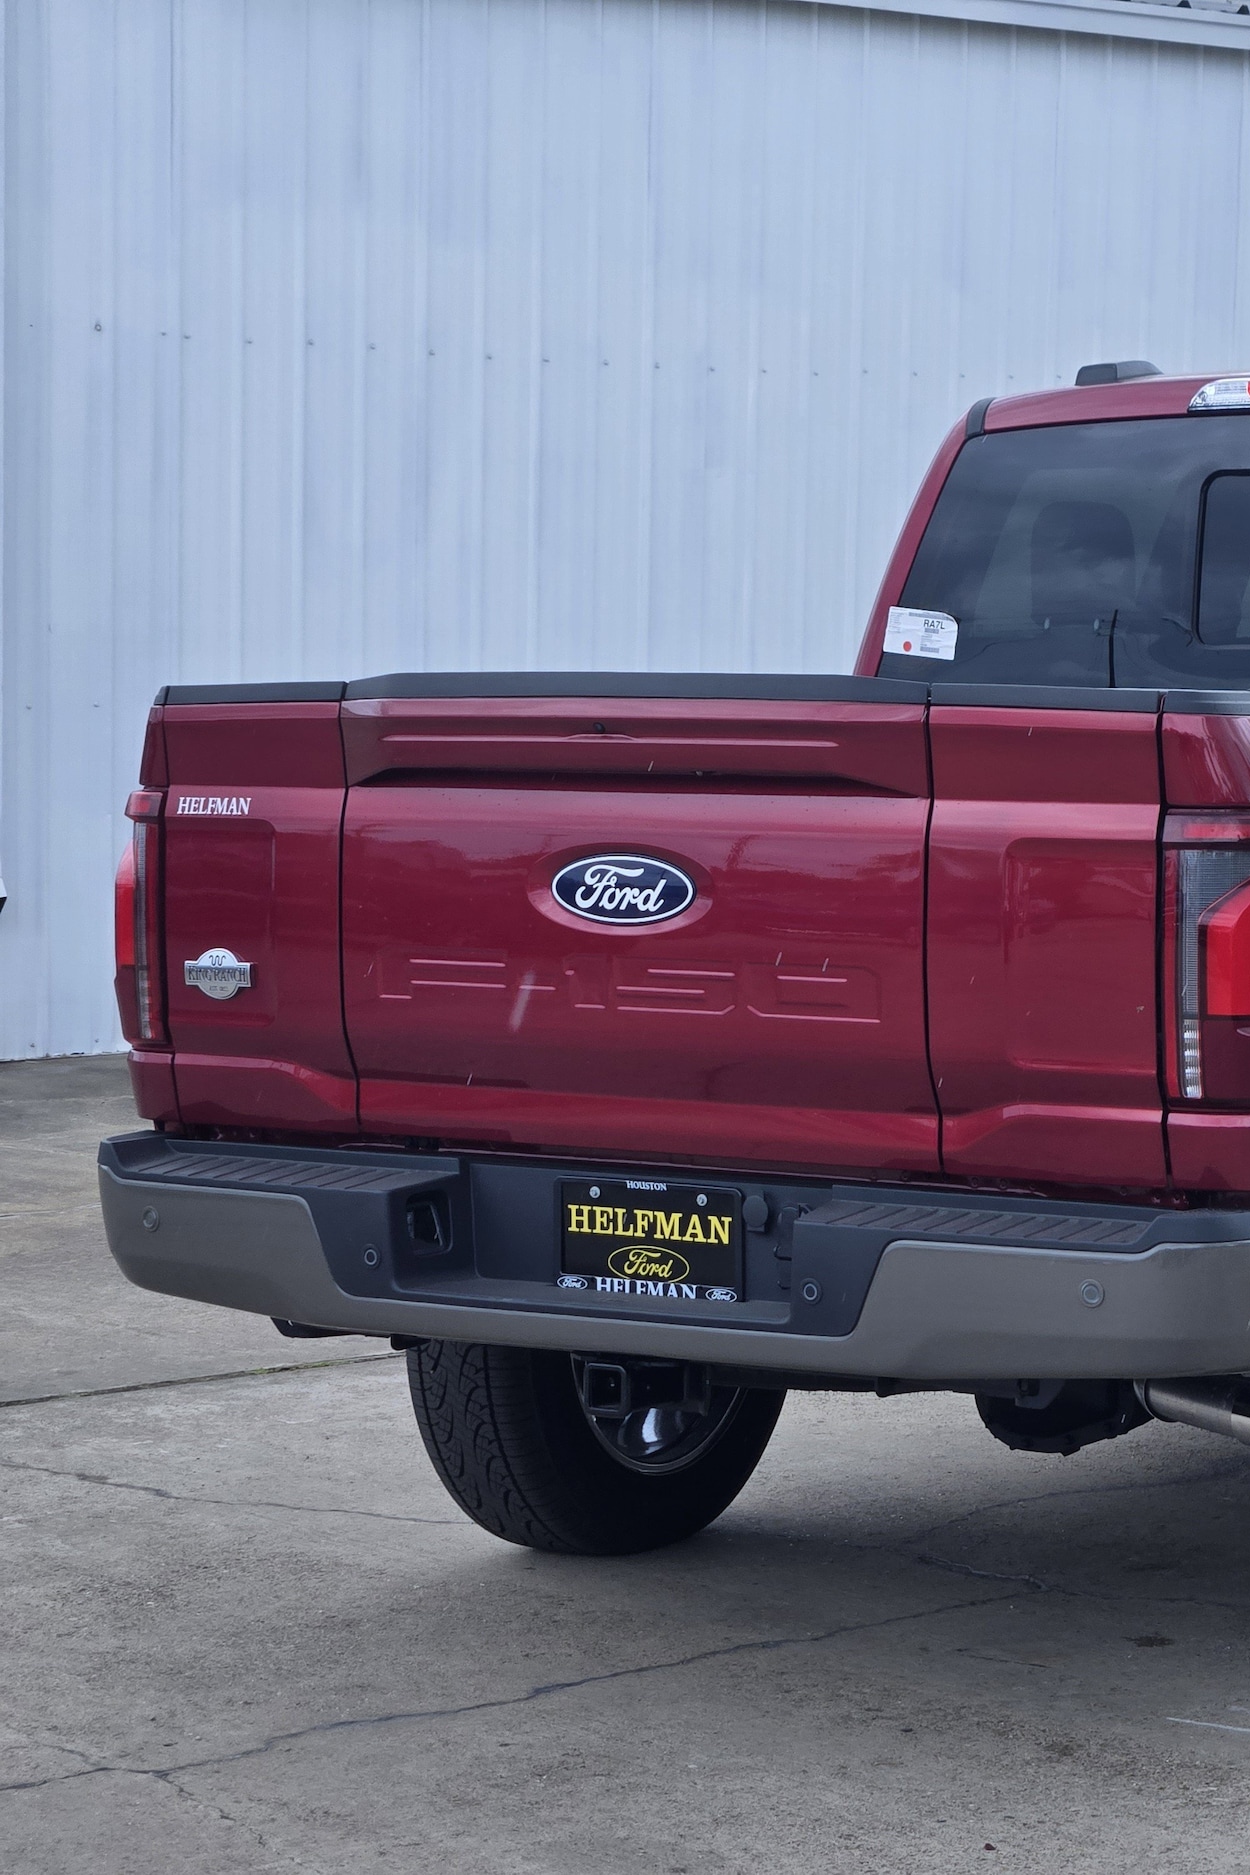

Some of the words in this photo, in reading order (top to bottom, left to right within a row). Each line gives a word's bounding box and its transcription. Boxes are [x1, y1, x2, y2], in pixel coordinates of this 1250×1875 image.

[923, 619, 945, 630] RA7L
[177, 797, 251, 815] HELFMAN
[575, 864, 666, 912] Ford
[187, 965, 213, 982] KING
[213, 968, 248, 983] RANCH
[626, 1180, 667, 1191] HOUSTON
[567, 1204, 732, 1244] HELFMAN
[624, 1249, 673, 1278] Ford
[562, 1277, 582, 1289] Ford
[711, 1290, 732, 1301] Ford
